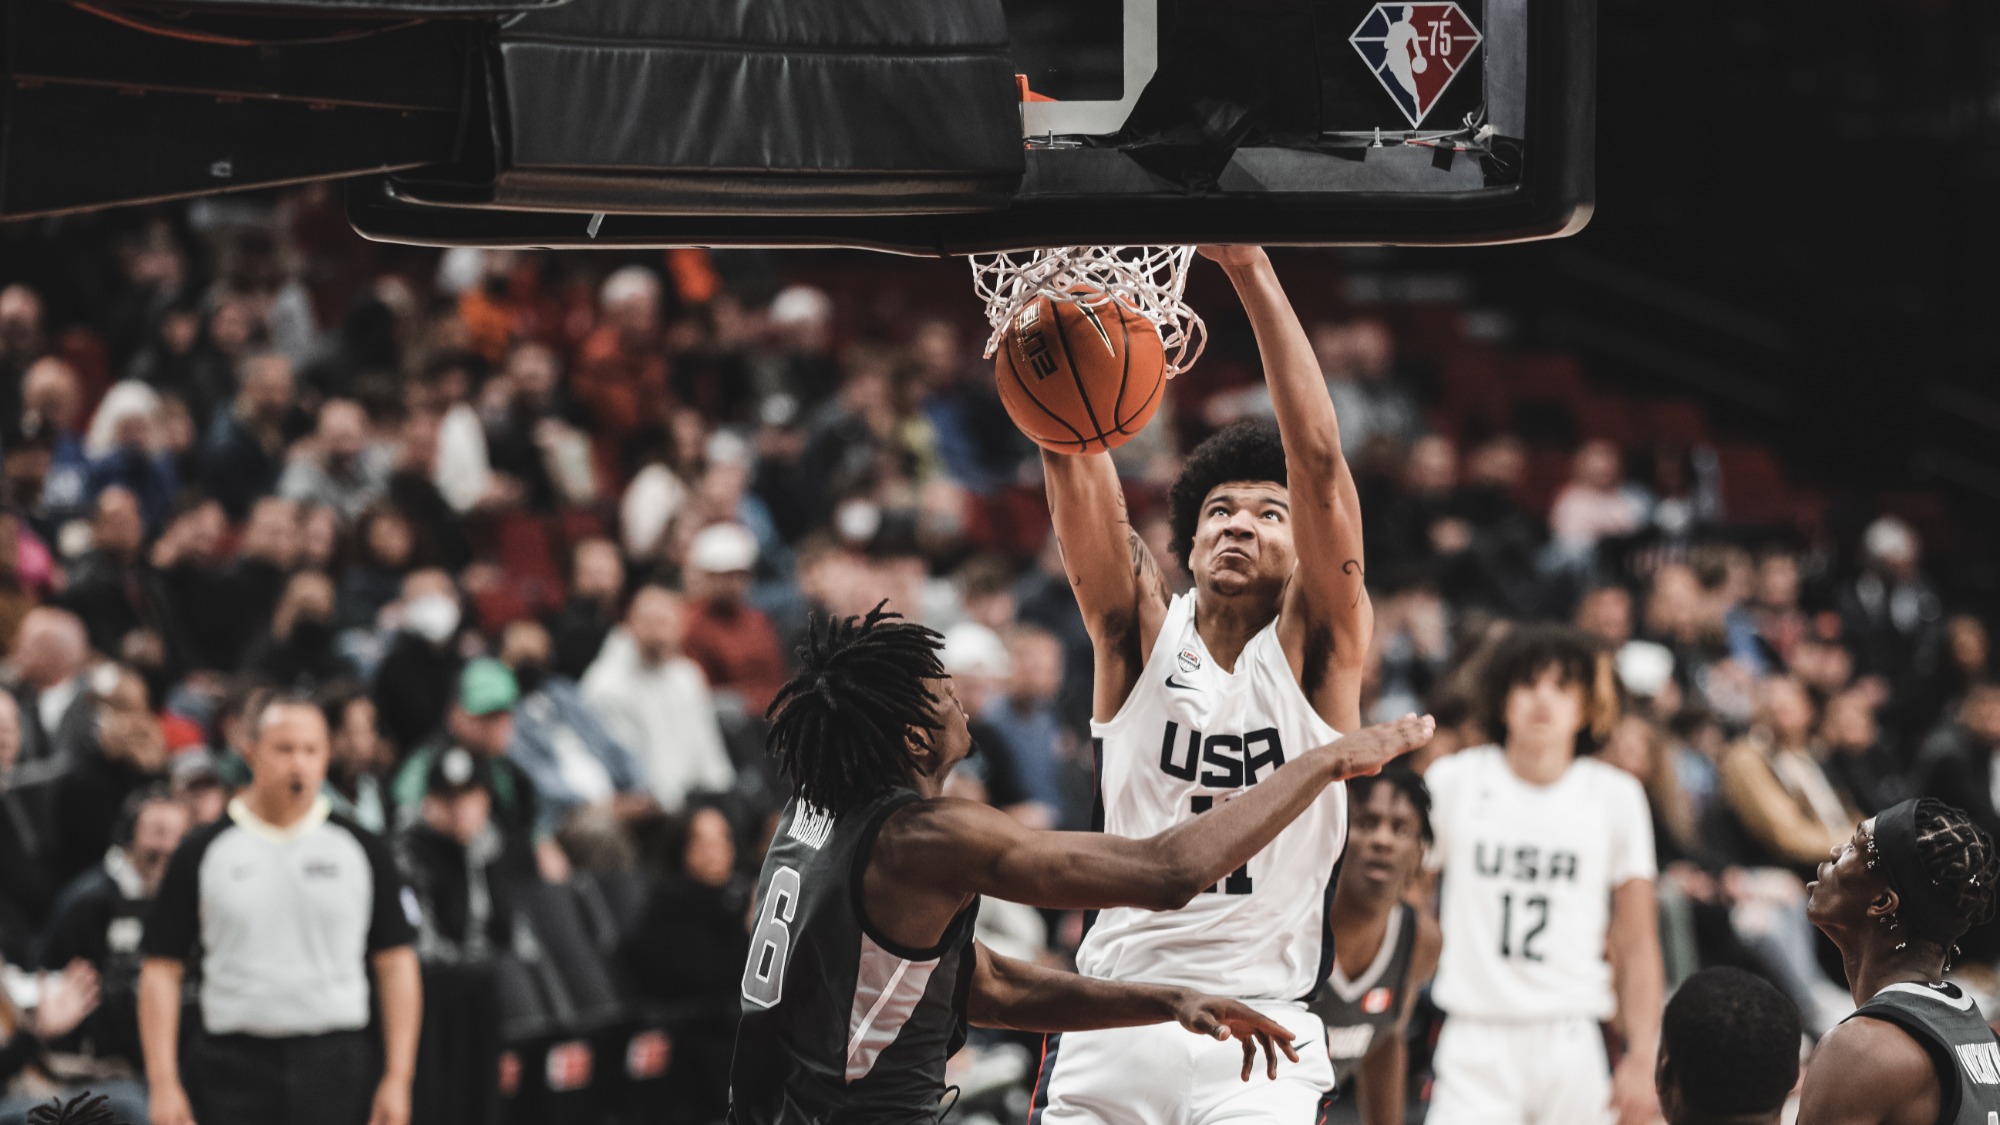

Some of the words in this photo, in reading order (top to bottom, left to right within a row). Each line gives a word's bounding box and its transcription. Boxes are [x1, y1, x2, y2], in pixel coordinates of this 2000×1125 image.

[1428, 21, 1451, 56] 75
[1160, 721, 1285, 788] USA
[1475, 842, 1577, 881] USA
[741, 866, 800, 1008] 6
[1501, 892, 1550, 961] 12
